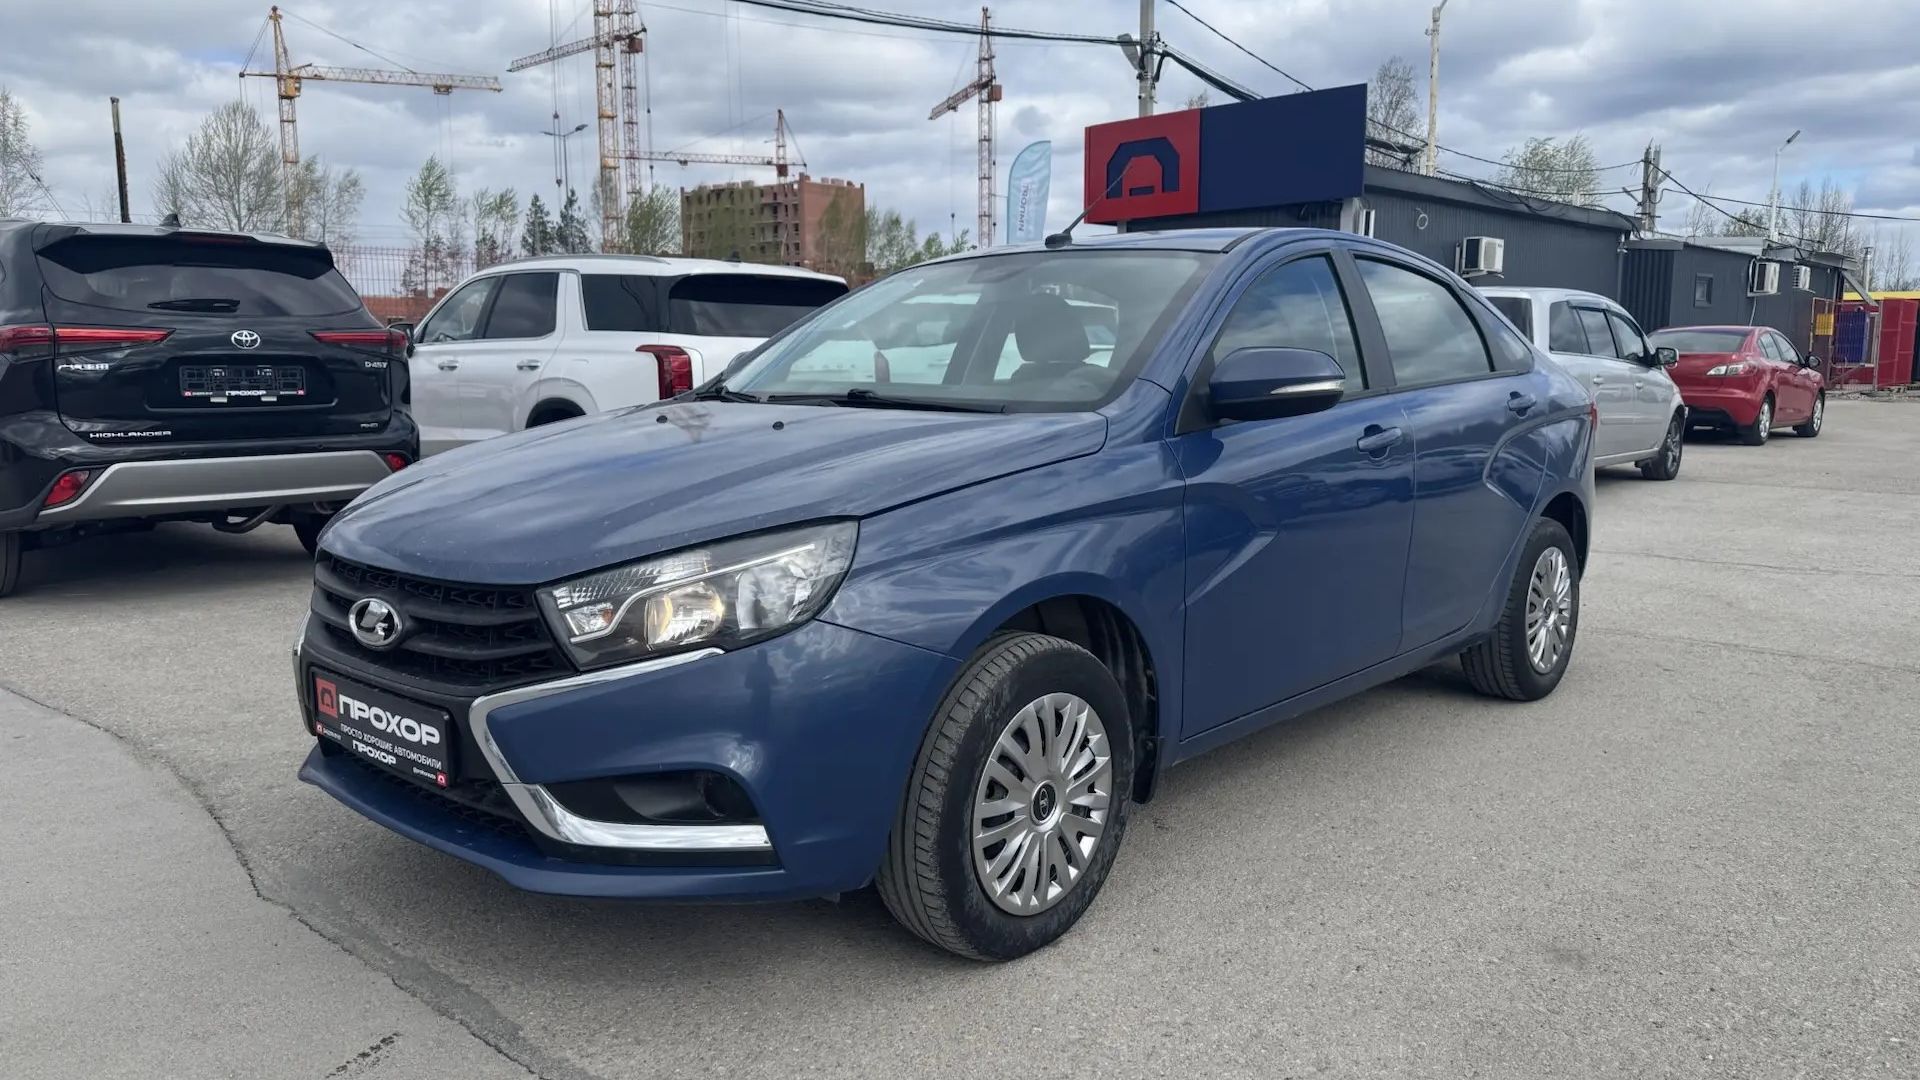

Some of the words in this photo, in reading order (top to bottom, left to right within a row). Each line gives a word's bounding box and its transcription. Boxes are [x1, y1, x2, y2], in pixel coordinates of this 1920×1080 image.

[90, 430, 172, 438] HIGHLANDER
[338, 693, 440, 746] ПРОХОР
[340, 723, 363, 740] ПРОСТО
[362, 731, 394, 753] ХОРОШИЕ
[393, 745, 442, 771] АВТОМОБИЛИ
[352, 739, 397, 765] ПРОХОР
